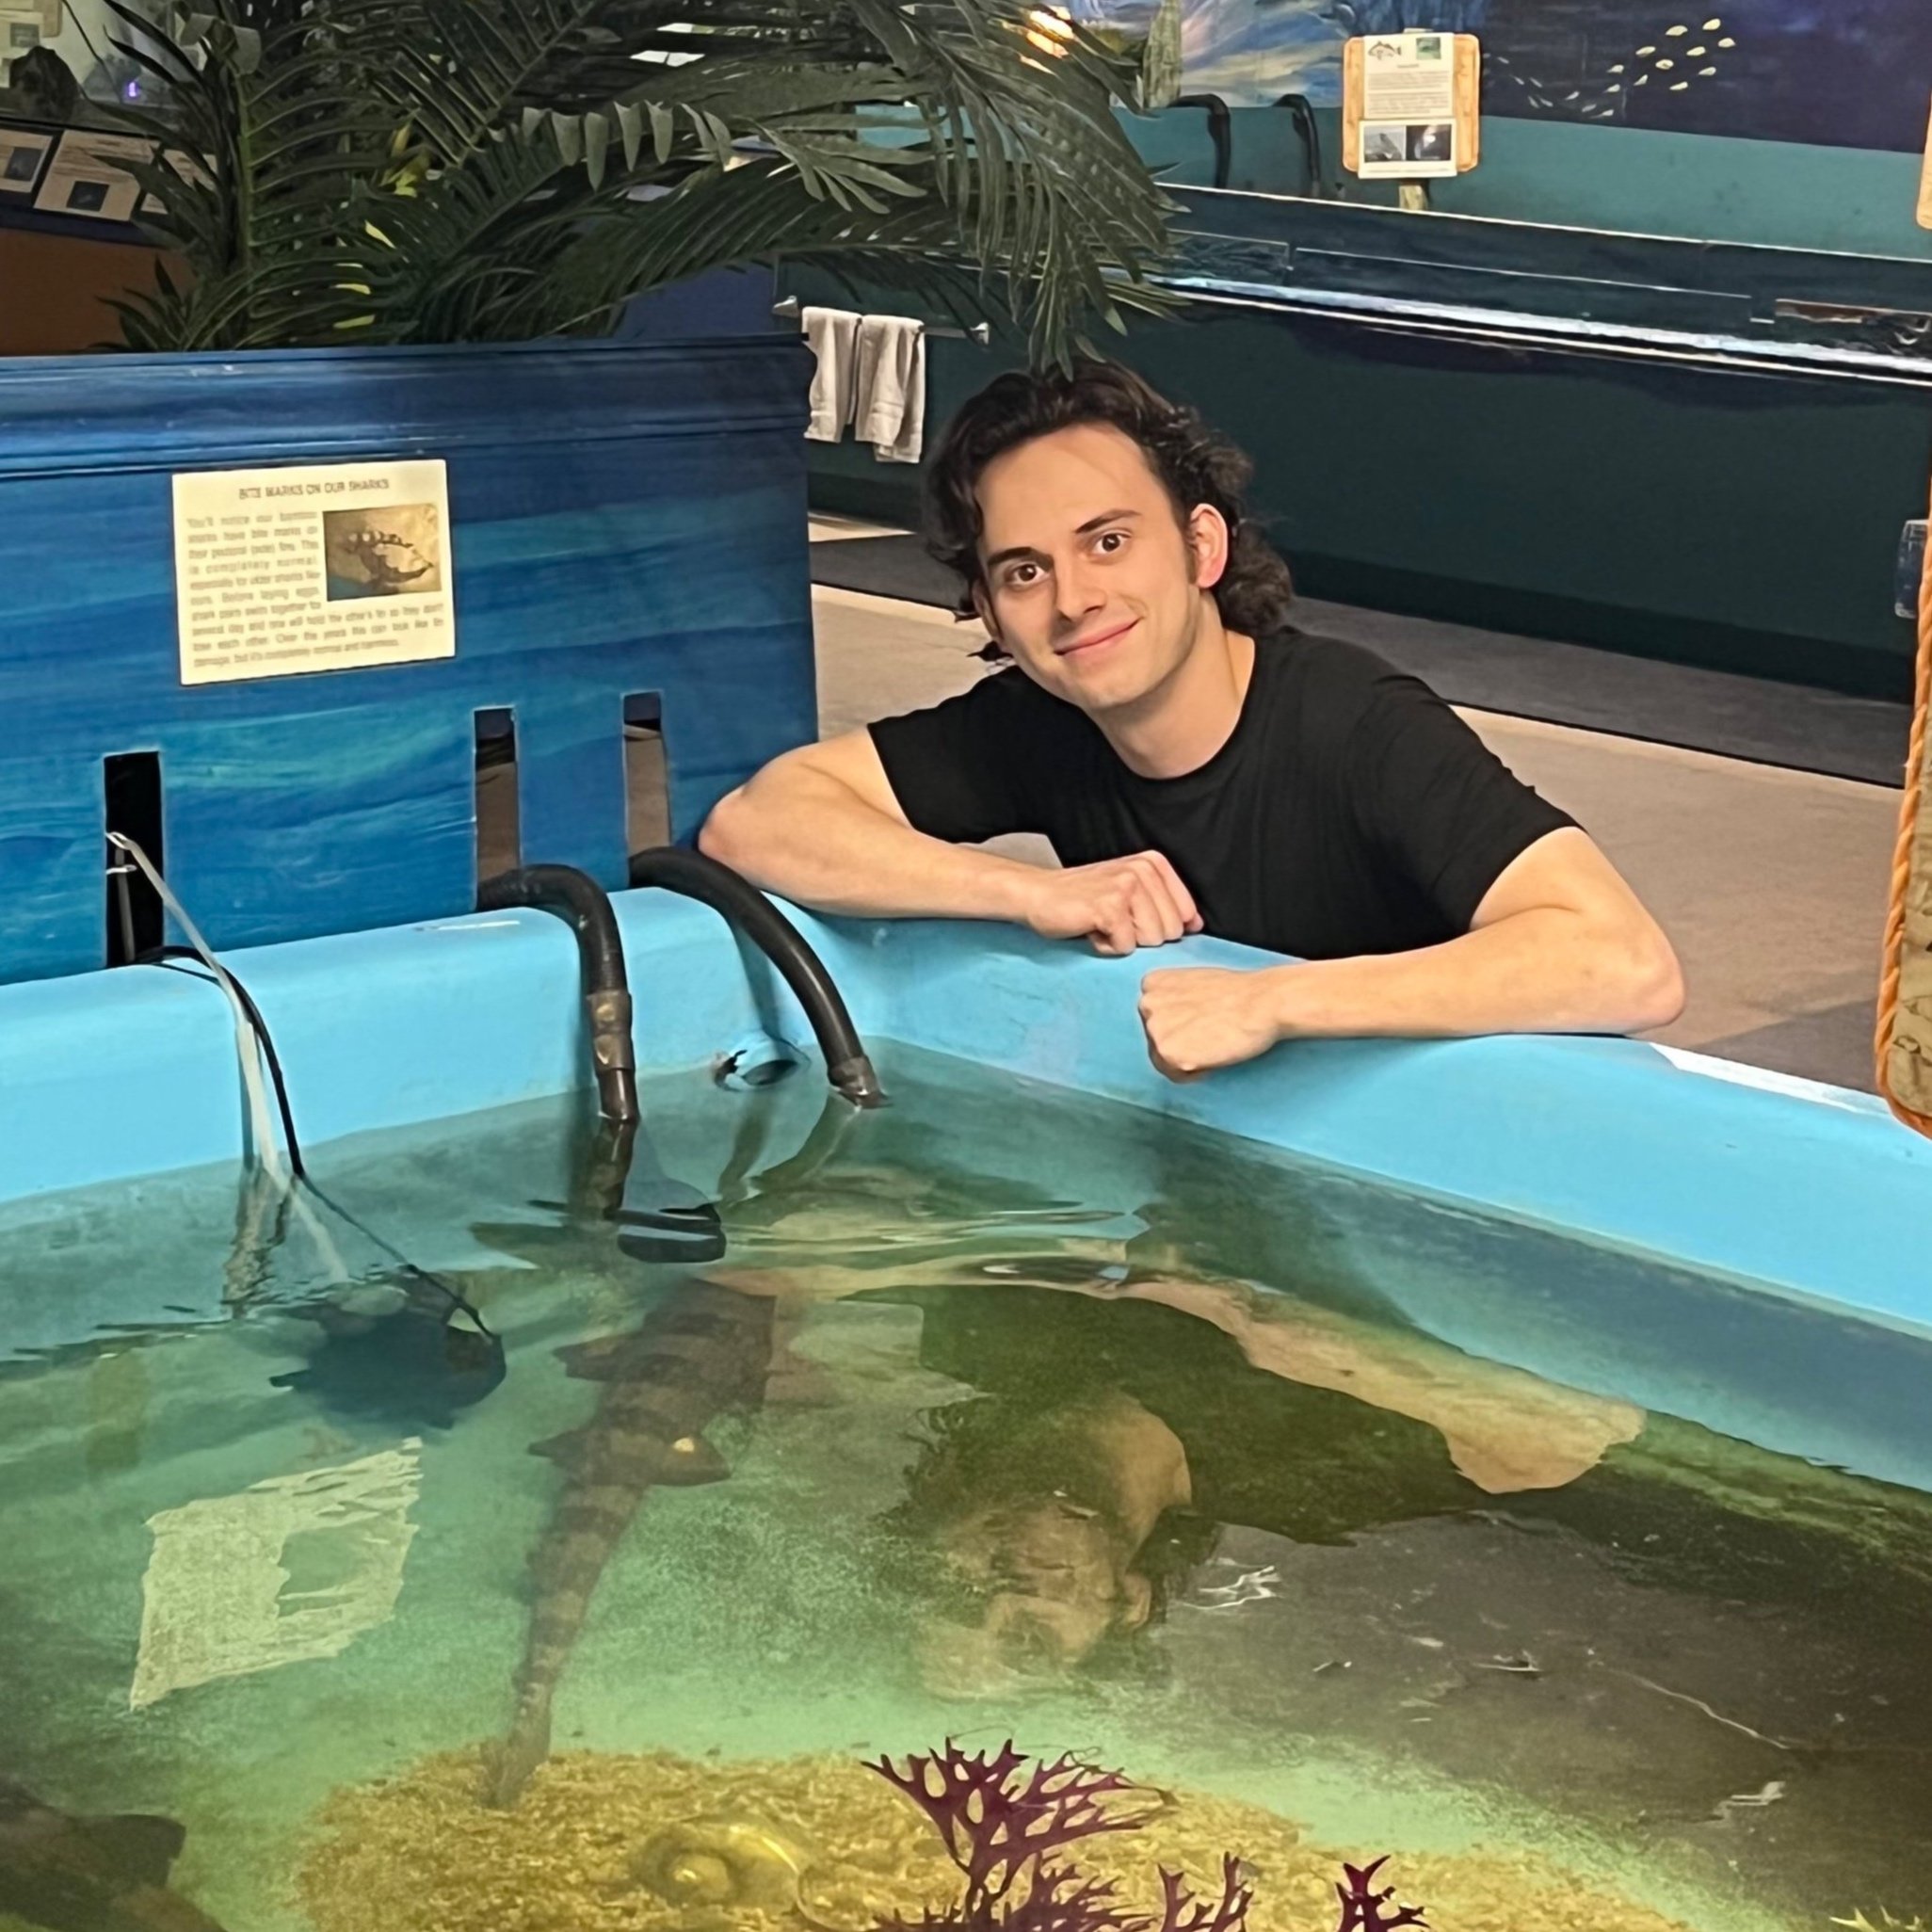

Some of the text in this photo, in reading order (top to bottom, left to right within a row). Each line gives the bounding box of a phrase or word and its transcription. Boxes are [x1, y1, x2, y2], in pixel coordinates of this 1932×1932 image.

[266, 484, 303, 497] MARKS
[306, 483, 321, 495] ON
[325, 481, 345, 493] OUR
[348, 478, 389, 491] SHARKS
